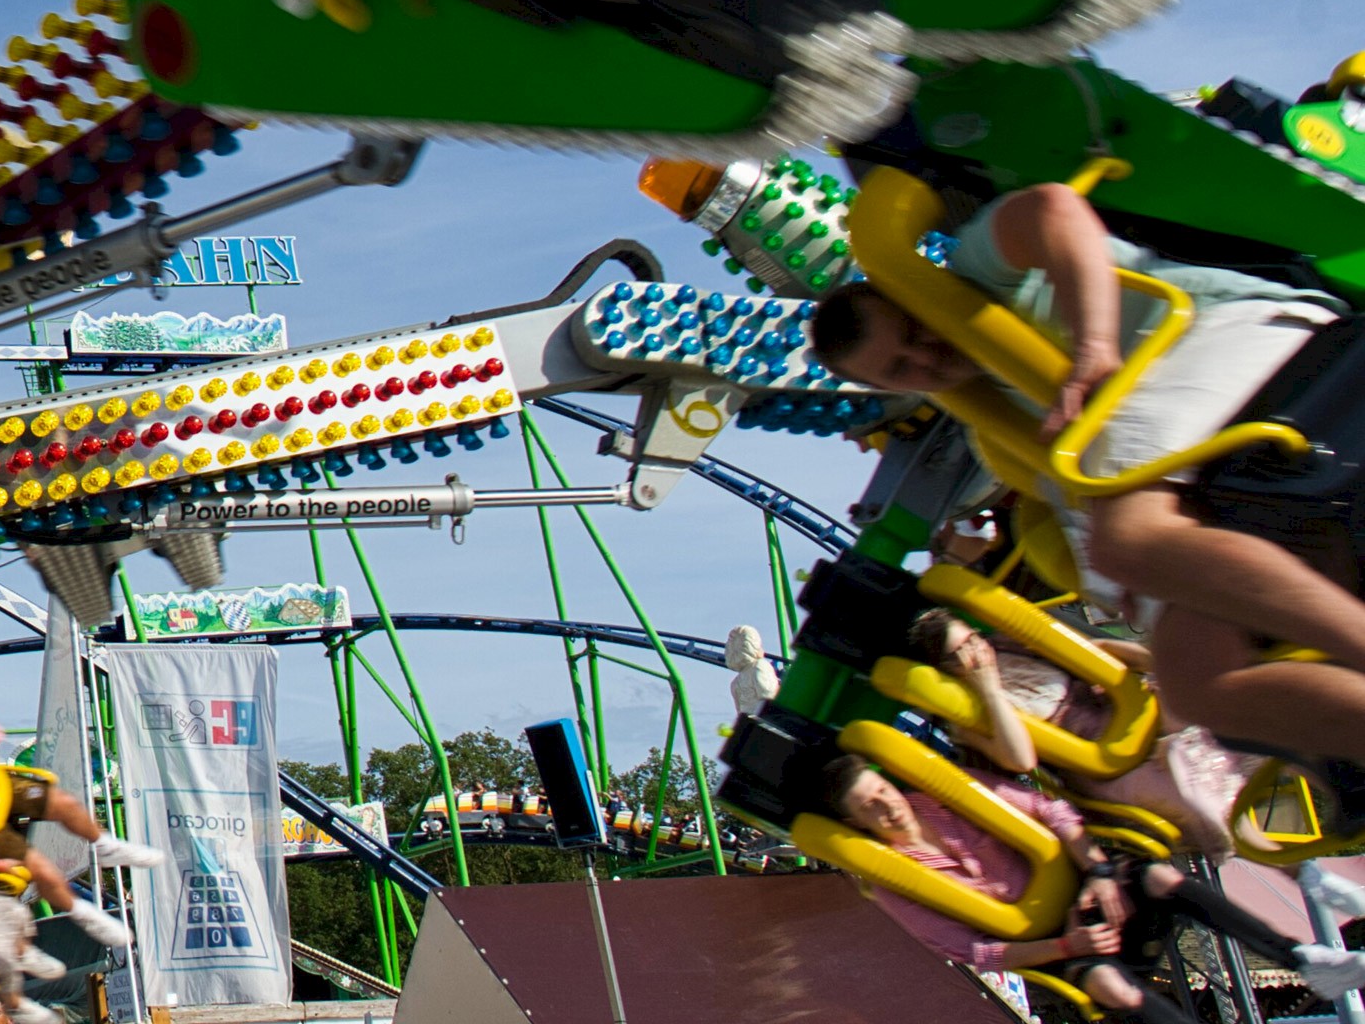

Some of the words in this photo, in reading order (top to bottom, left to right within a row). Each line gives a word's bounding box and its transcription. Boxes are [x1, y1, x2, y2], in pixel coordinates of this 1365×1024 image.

[180, 501, 257, 521] Power
[266, 499, 290, 517] to
[298, 498, 338, 517] the
[346, 494, 432, 518] people
